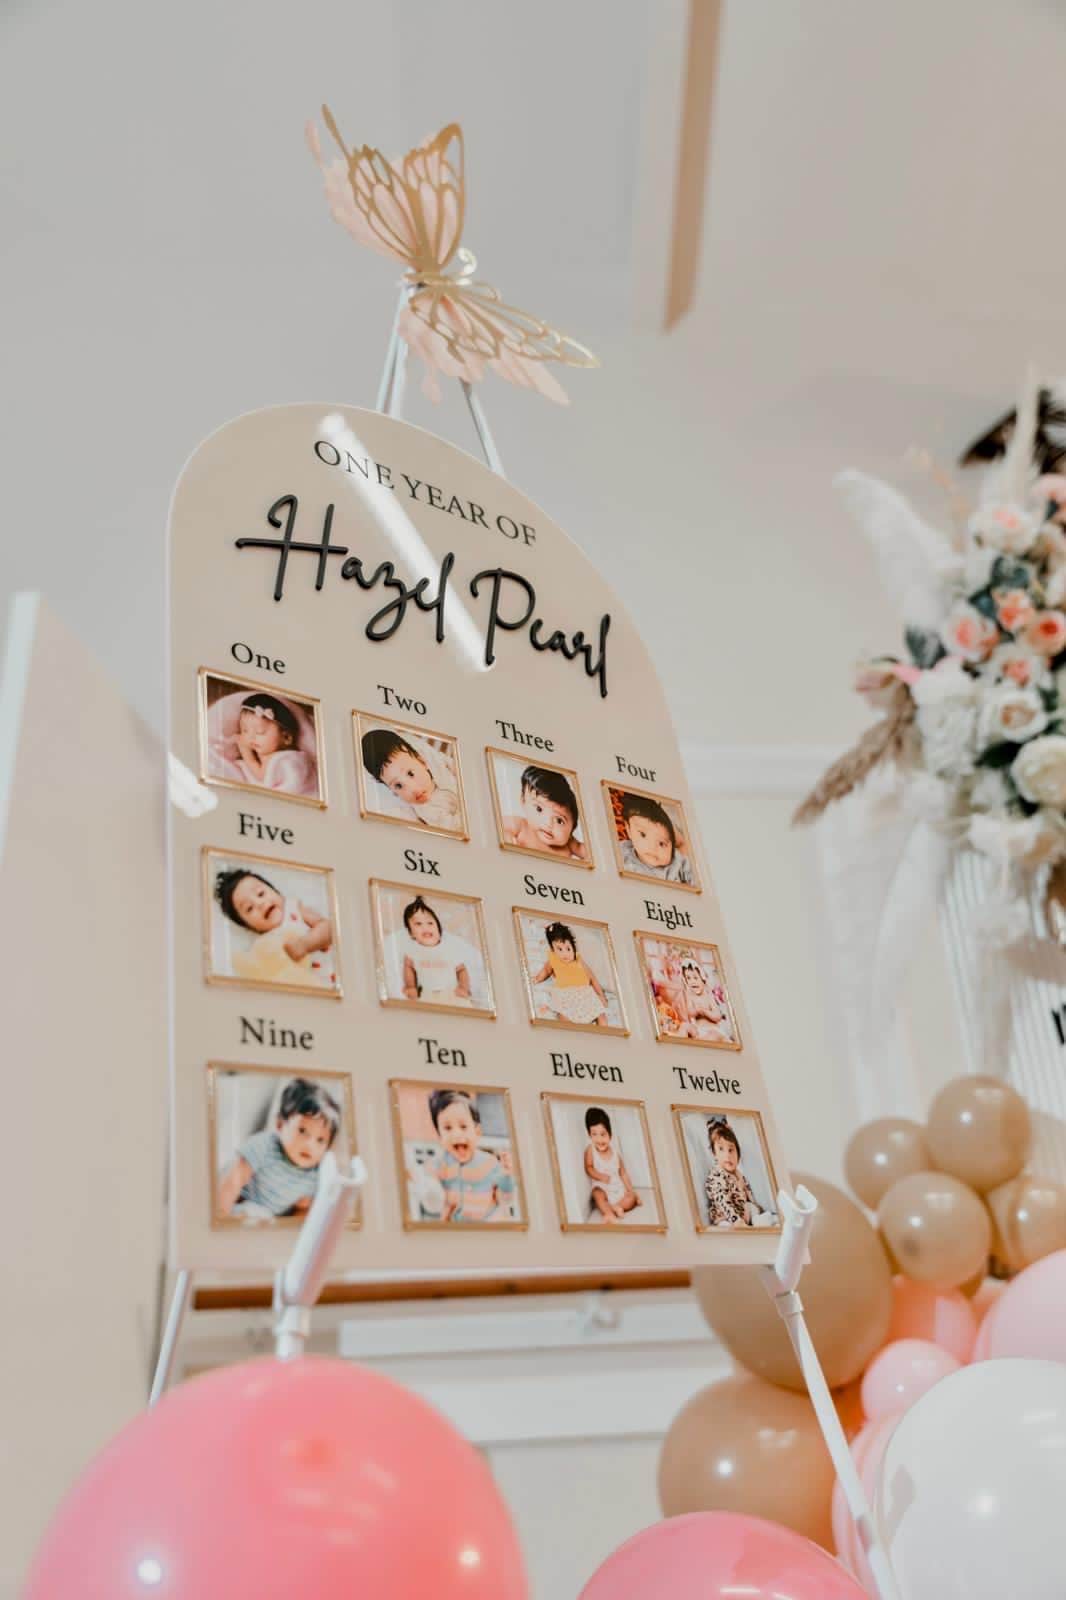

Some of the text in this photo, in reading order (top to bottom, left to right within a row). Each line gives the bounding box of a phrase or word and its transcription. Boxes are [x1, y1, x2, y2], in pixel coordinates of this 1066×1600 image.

[313, 440, 536, 547] ONE YEAR OF
[235, 494, 611, 699] Hazel Pearl
[230, 642, 286, 675] One
[376, 684, 428, 716] Two
[495, 719, 555, 753] Three
[615, 755, 657, 783] Four
[237, 812, 295, 846] Five
[403, 848, 441, 877] Six
[523, 874, 585, 906] Seven
[643, 899, 694, 931] Eight
[239, 1015, 314, 1051] Nine
[417, 1037, 468, 1068] Ten
[548, 1052, 625, 1084] Eleven
[671, 1066, 742, 1096] Twelve
